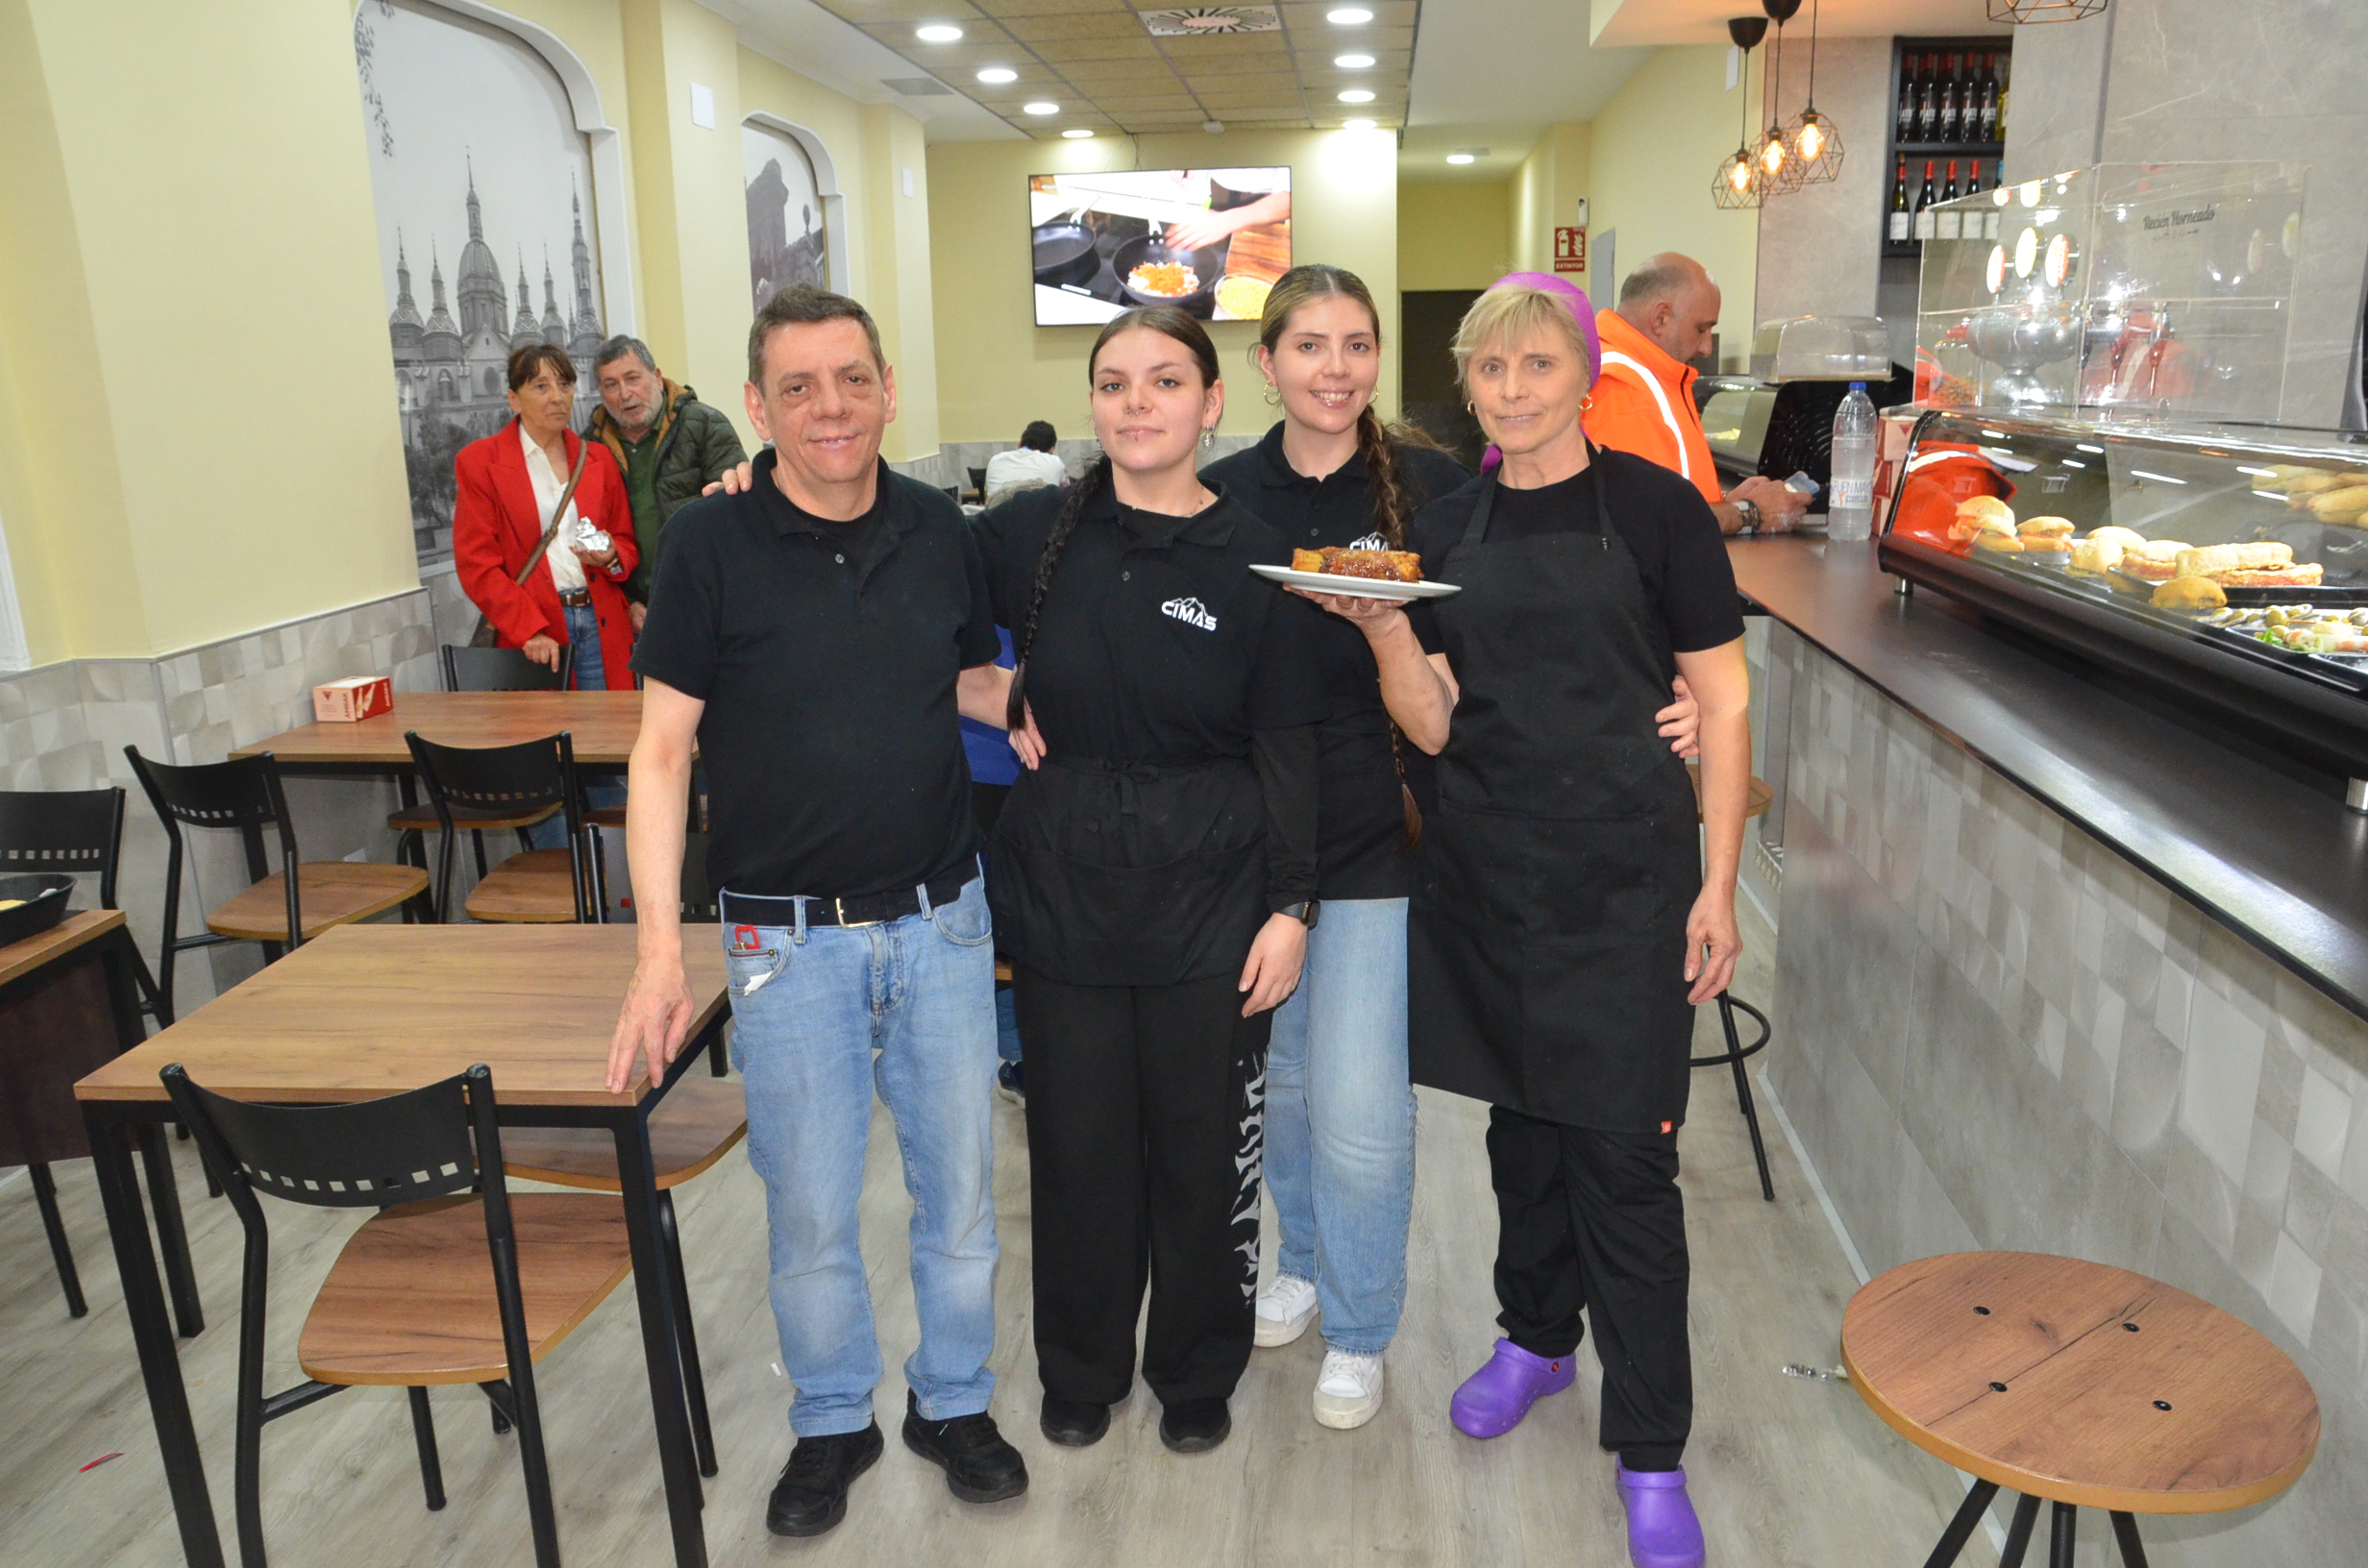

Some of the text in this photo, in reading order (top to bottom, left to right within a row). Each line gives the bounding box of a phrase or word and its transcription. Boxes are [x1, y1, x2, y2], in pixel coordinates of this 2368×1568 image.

[2143, 204, 2215, 231] Recién Horneado
[1349, 538, 1390, 551] CIMA
[1161, 600, 1218, 631] CIMAS
[341, 692, 351, 719] AMBAR
